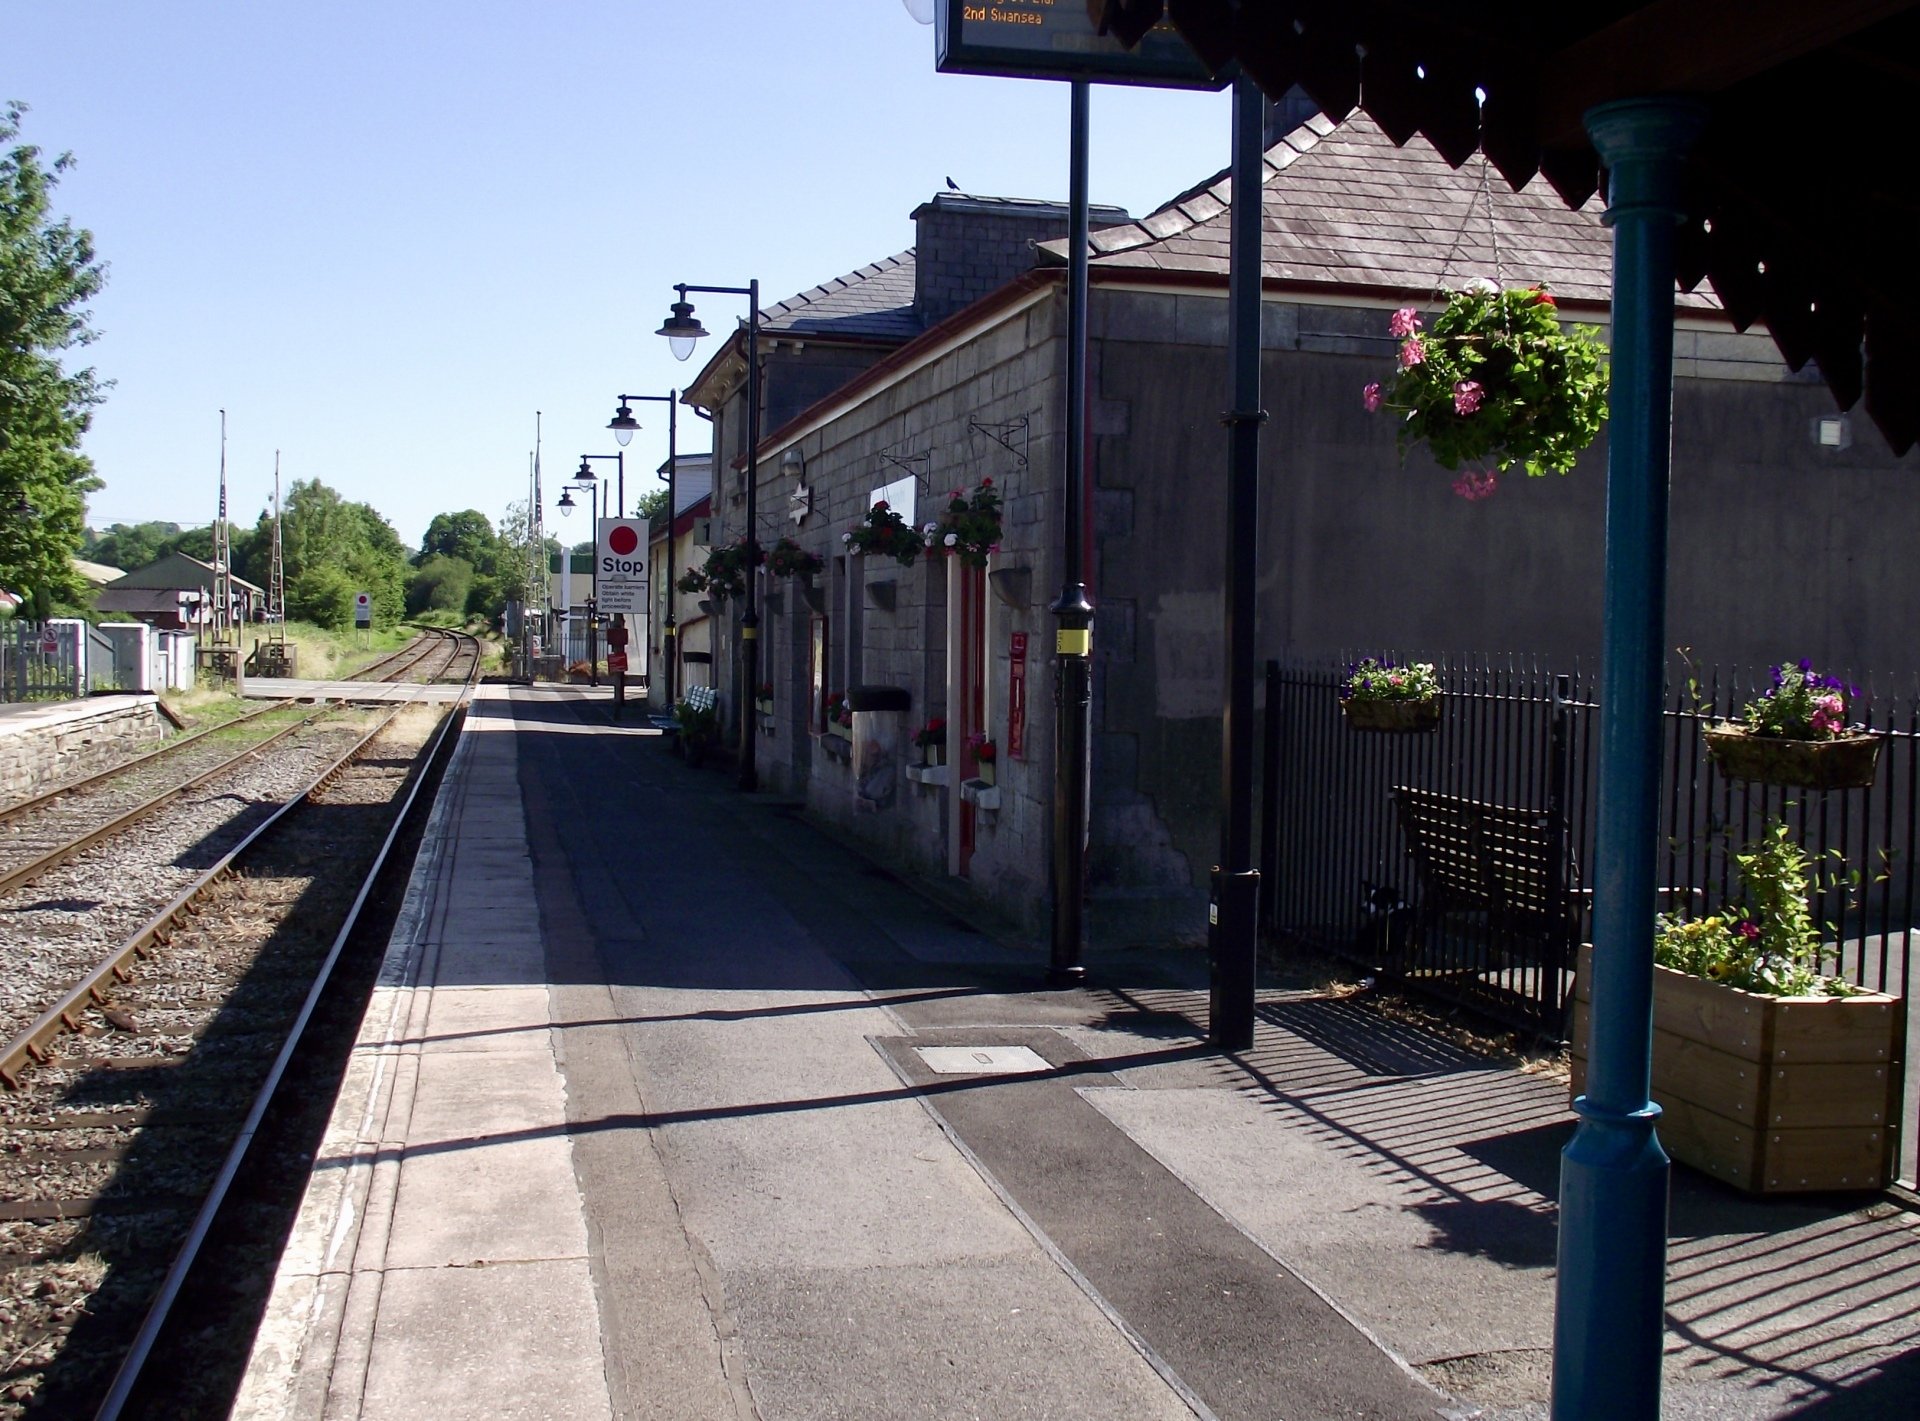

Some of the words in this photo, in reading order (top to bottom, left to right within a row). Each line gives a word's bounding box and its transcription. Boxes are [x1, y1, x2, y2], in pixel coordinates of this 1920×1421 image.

[963, 6, 986, 21] 2nd
[990, 7, 1042, 25] Swansea
[603, 557, 643, 576] Stop
